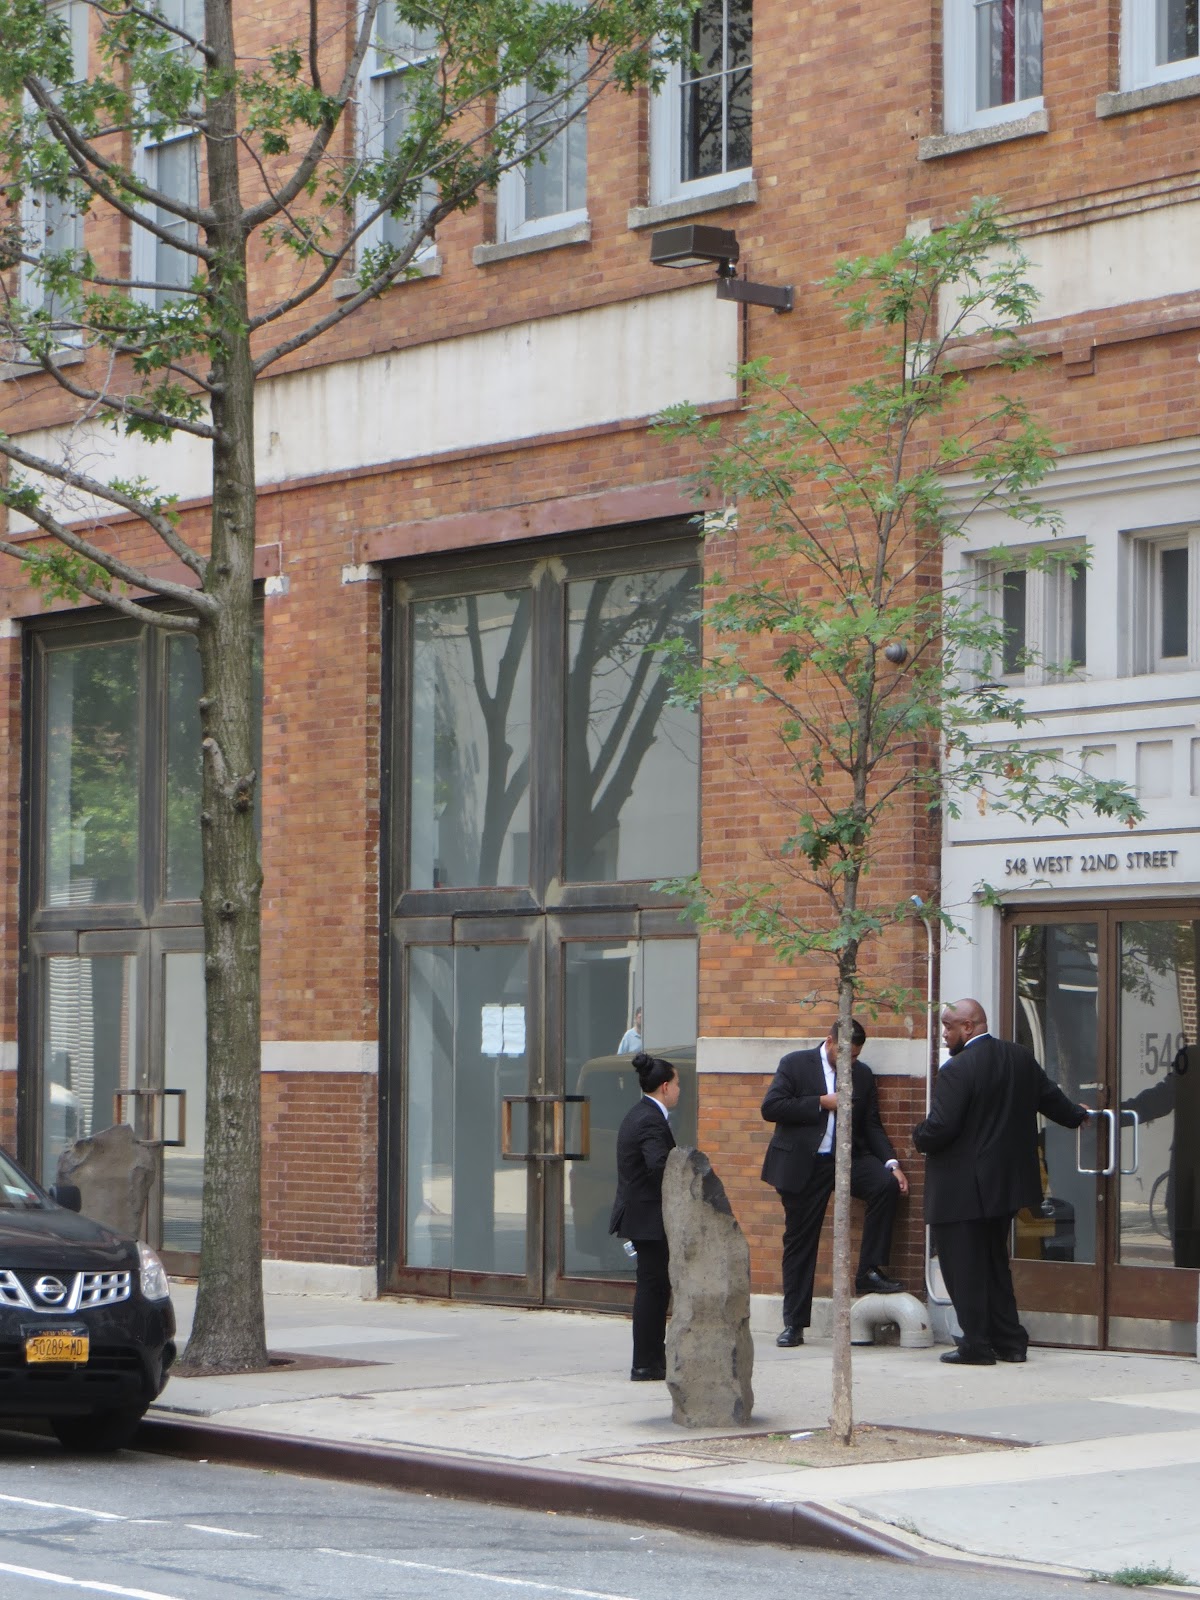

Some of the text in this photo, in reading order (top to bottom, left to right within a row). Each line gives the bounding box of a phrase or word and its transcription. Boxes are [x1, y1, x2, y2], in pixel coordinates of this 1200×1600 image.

[1004, 850, 1178, 875] 548 WEST 22ND STREET
[1145, 1033, 1188, 1075] 548
